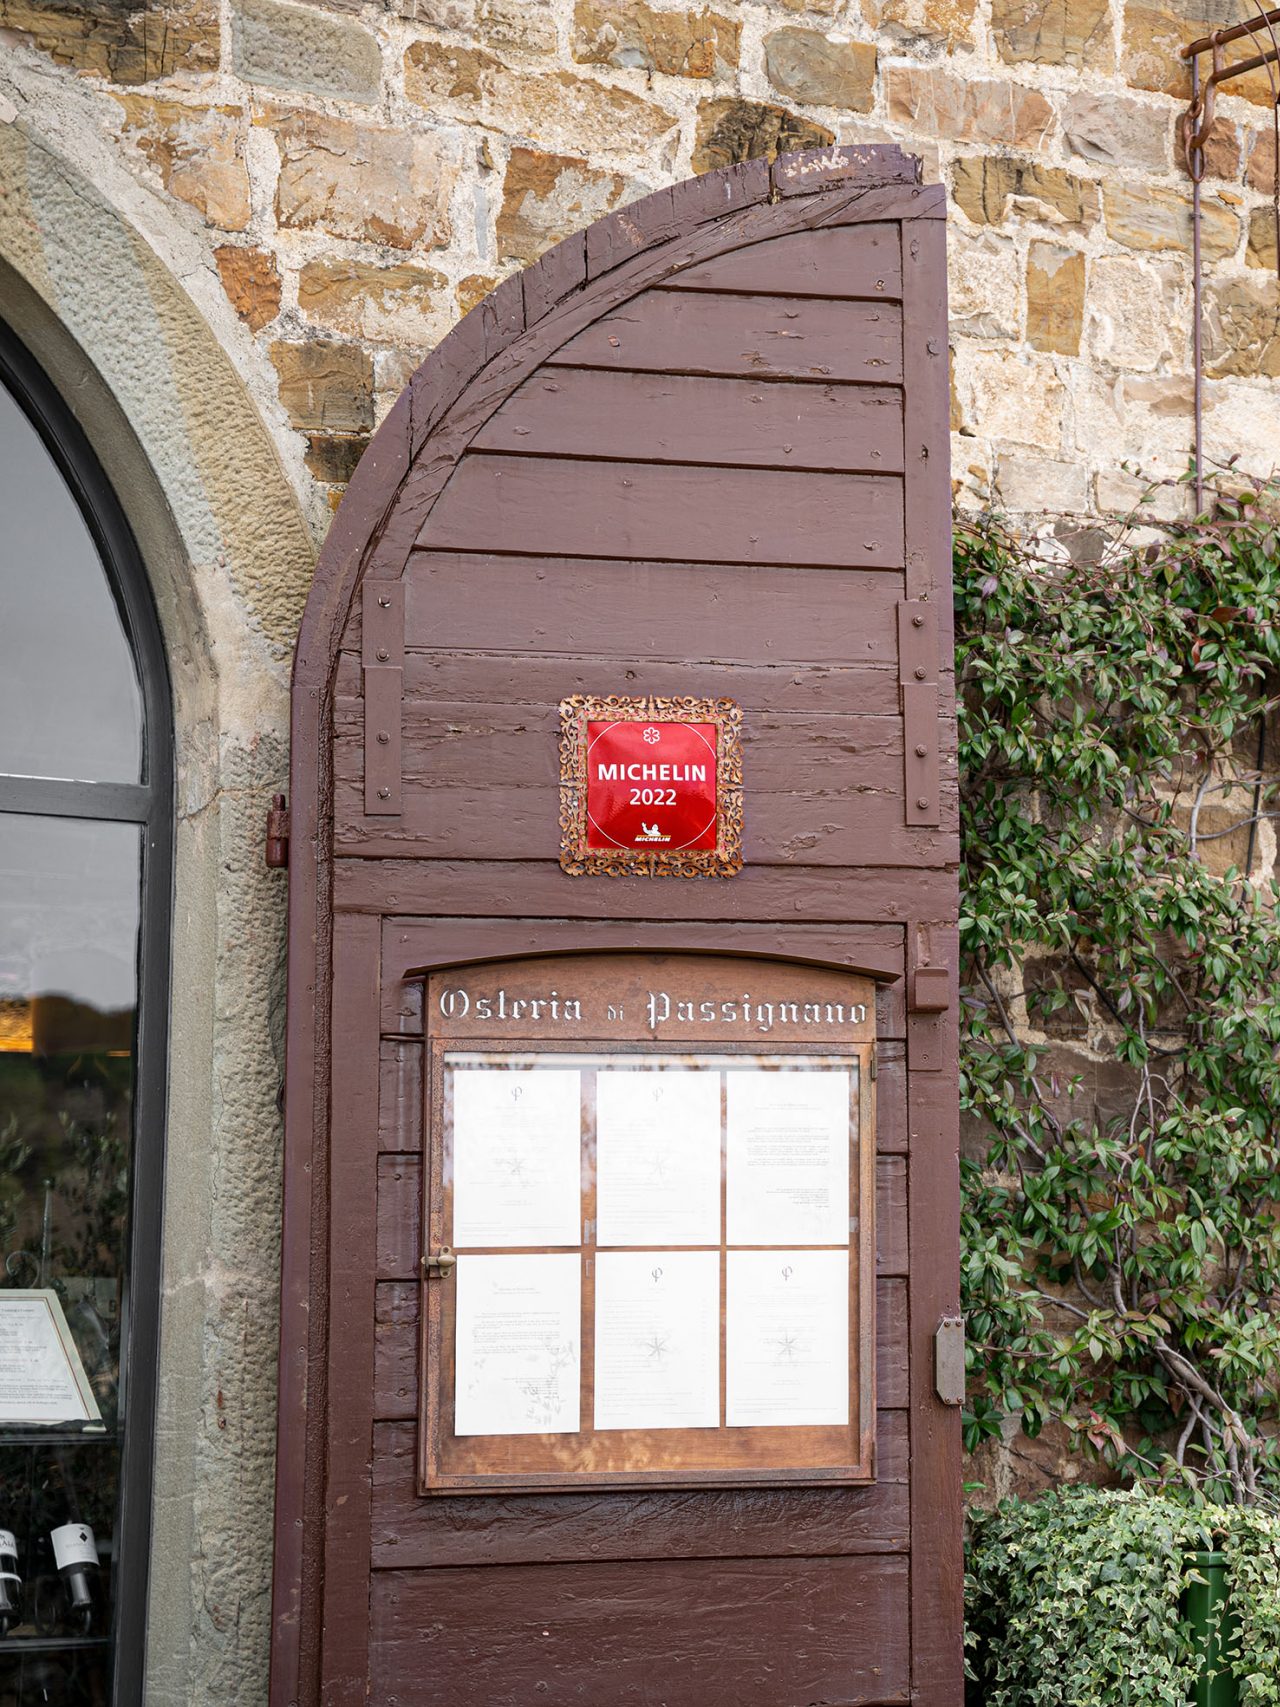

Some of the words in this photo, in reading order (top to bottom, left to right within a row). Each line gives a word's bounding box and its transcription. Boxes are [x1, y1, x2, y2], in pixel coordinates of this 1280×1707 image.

[597, 763, 706, 782] MICHELIN
[629, 788, 677, 806] 2022
[439, 990, 582, 1020] Osteria
[606, 1004, 624, 1021] di
[646, 991, 867, 1031] Passignano
